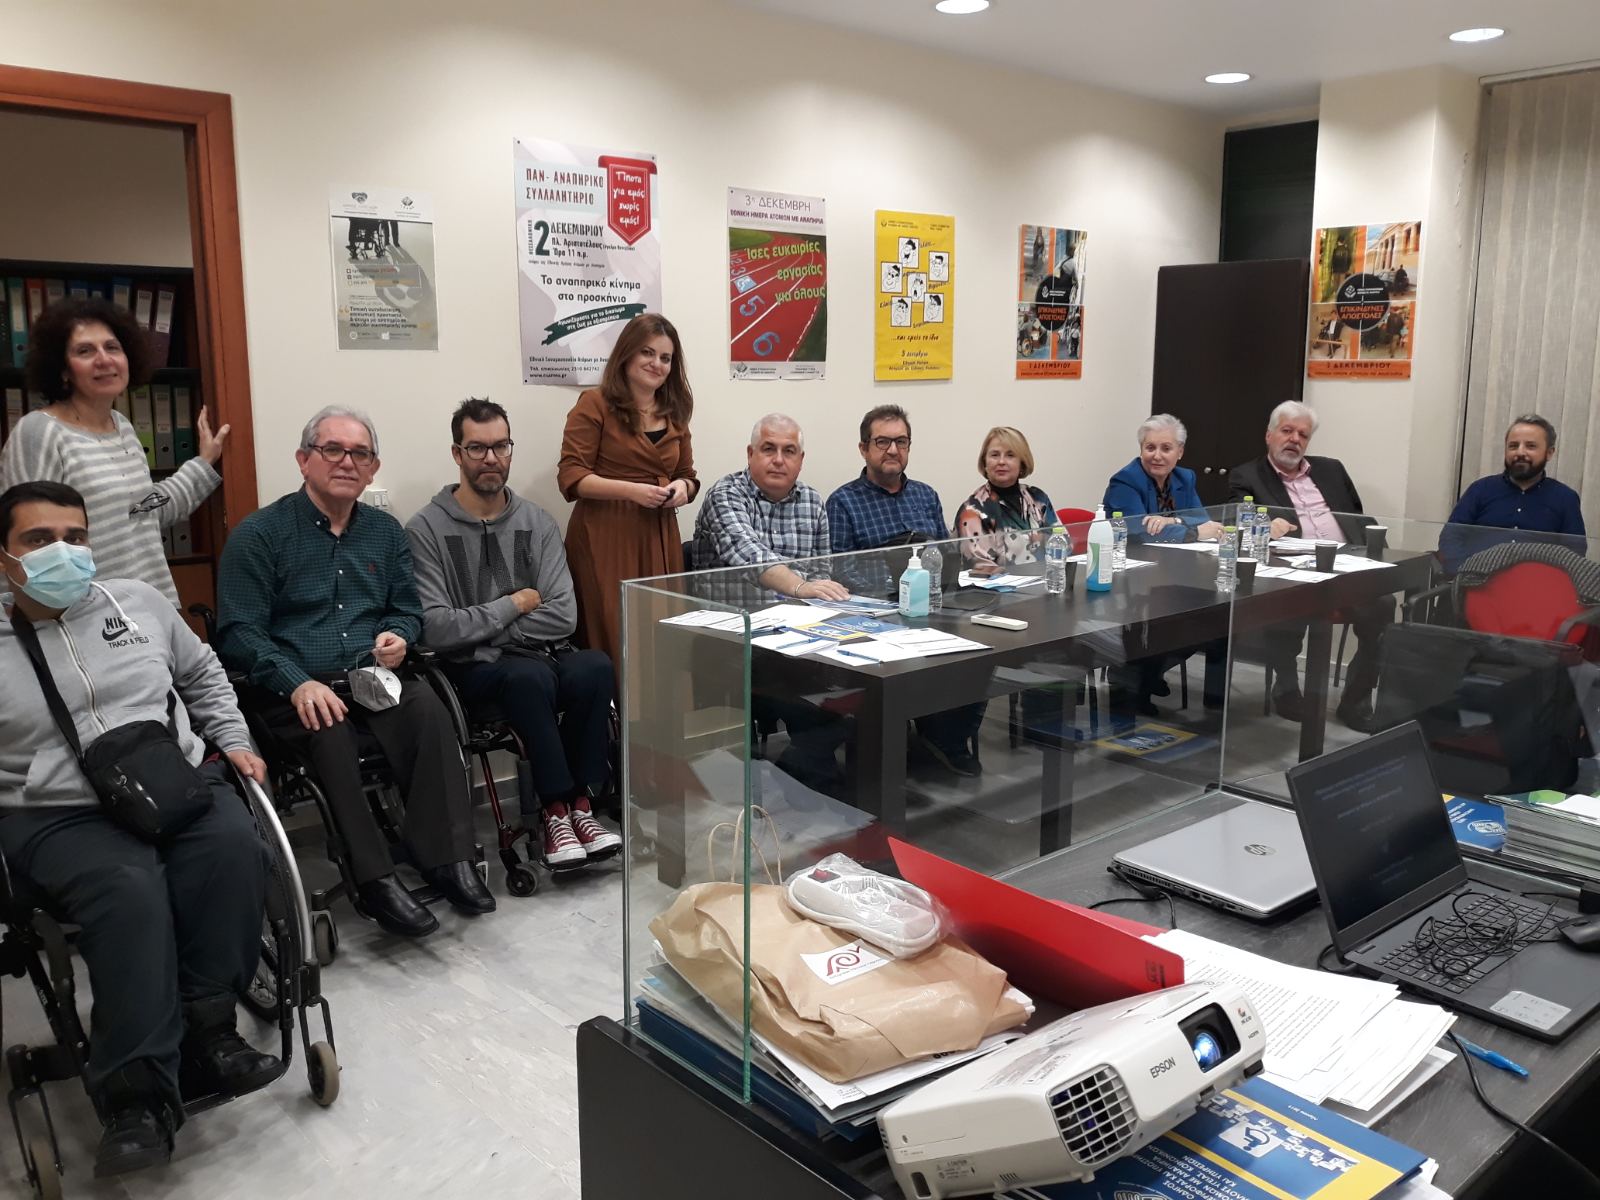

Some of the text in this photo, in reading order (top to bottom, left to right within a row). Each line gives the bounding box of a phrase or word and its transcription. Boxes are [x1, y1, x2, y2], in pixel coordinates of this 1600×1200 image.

[553, 171, 604, 189] ΑΝΑΠΗΡΙΚΟ
[526, 187, 594, 206] ΣΥΛΛΑΛΗΤΗΡΙΟ
[613, 188, 625, 199] για
[758, 197, 811, 212] ΔΕΚΕΜΒΡΗ
[730, 209, 750, 217] ΕΘΝΙΚΗ
[751, 211, 769, 219] ΗΜΕΡΑ
[769, 213, 791, 222] ΑΤΟΜΩΝ
[799, 217, 824, 225] ΑΝΑΠΗΡΙΑ
[534, 219, 604, 257] 2 ΔΕΚΕΜΒΡΙΟΥ
[551, 237, 562, 246] Πλ.
[563, 238, 603, 251] Αριστοτέλους
[568, 249, 575, 257] 11
[772, 240, 820, 256] ευκαιρίες
[777, 264, 823, 281] εργασίας
[541, 275, 641, 293] Το αναπηρικό κίνημα
[558, 292, 627, 304] στο προσκήνιο
[793, 286, 826, 301] όλους
[1340, 305, 1384, 313] ΕΠΙΚΙΝΔΥΝΕΣ
[105, 616, 131, 630] NIK
[108, 639, 129, 649] TRACK
[134, 636, 150, 644] FIELD
[1149, 1057, 1177, 1079] EPSON
[1163, 1171, 1177, 1180] ΚΑΙ
[1183, 1155, 1237, 1187] ΚΑΙ ΥΠΗΡΕΣΙΩΝ
[1189, 1177, 1202, 1185] ΜΕ
[1163, 1180, 1194, 1200] ΟΔΗΓΟΣ
